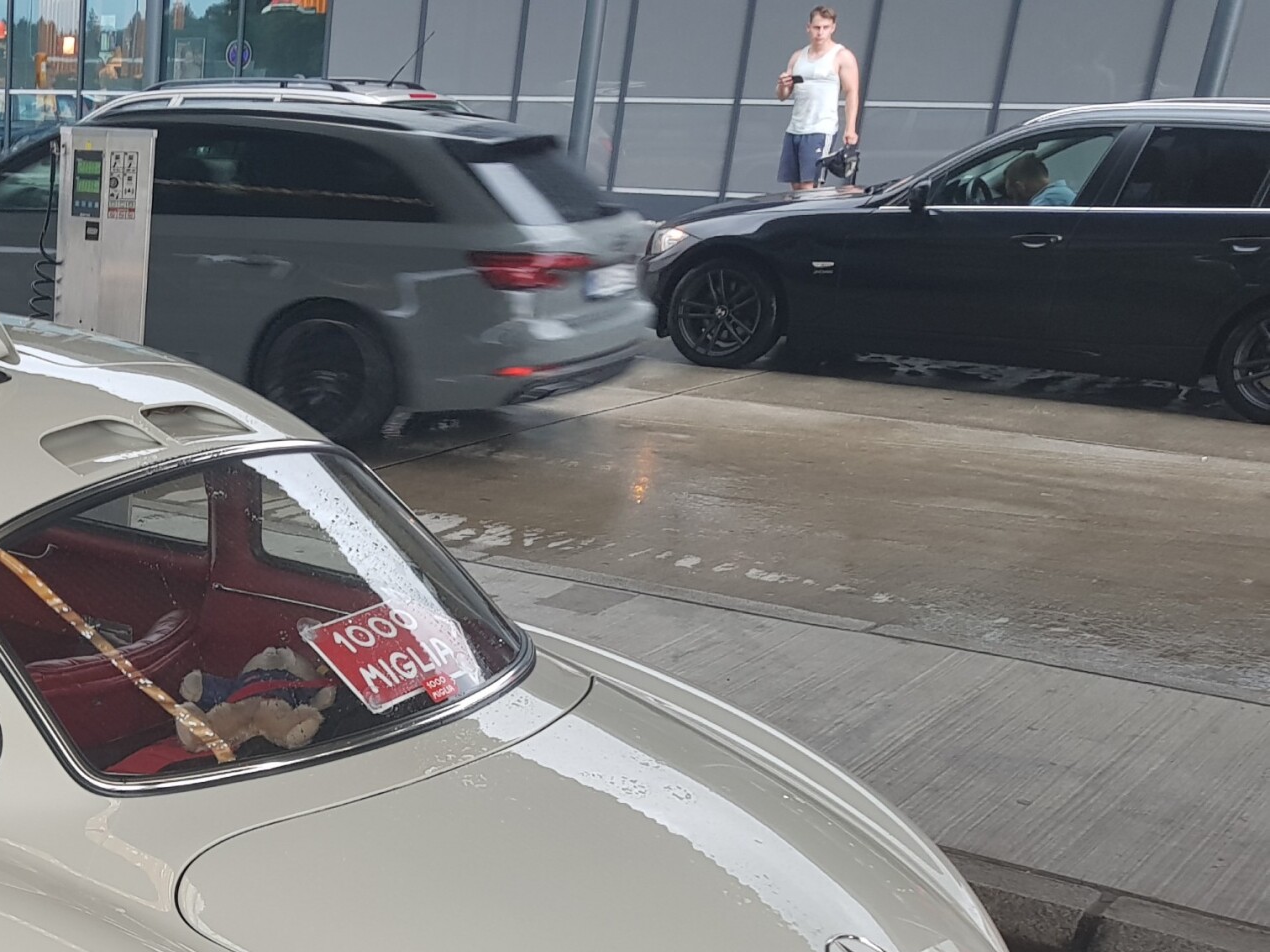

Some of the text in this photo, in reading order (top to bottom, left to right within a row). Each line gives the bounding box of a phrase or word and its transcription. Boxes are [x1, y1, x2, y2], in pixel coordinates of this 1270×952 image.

[332, 608, 419, 654] 1000
[359, 637, 455, 694] MIGLIA
[426, 676, 447, 689] 1000
[432, 685, 455, 700] MIGLIA
